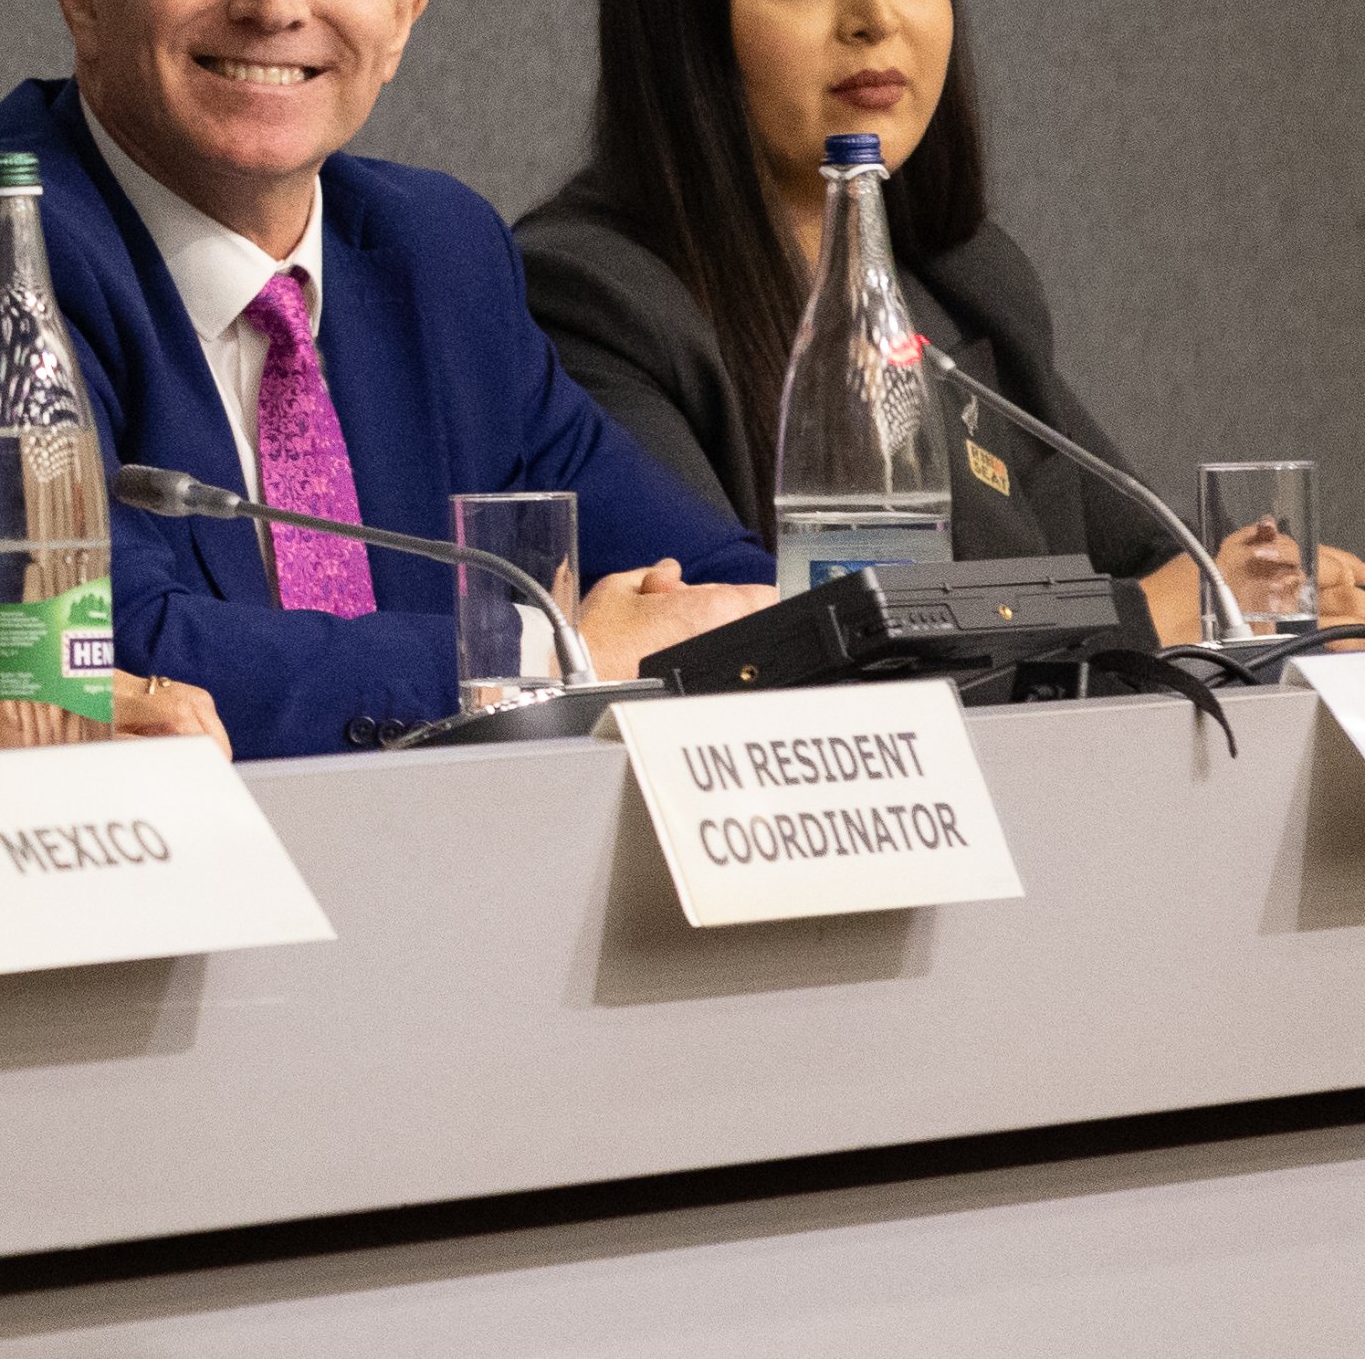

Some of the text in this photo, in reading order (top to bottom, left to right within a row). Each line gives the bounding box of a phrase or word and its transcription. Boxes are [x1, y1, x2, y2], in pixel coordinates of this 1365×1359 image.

[681, 731, 925, 793] UN RESIDENT
[698, 801, 969, 867] COORDINATOR
